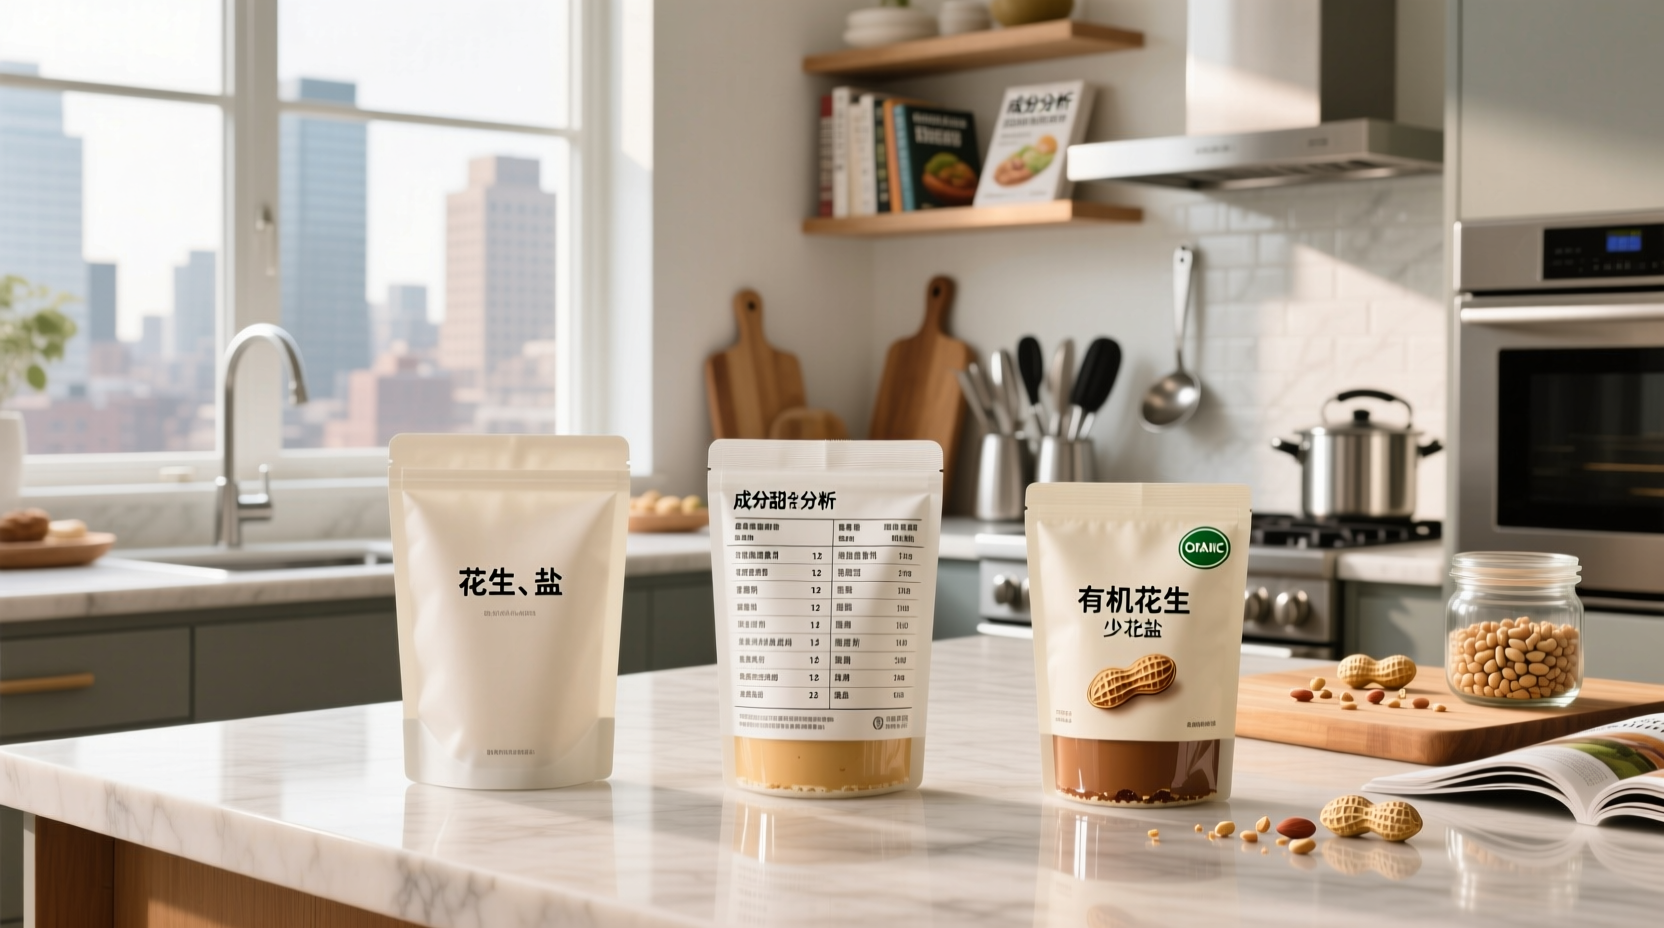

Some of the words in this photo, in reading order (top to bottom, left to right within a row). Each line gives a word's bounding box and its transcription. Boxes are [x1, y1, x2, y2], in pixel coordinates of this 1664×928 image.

[459, 567, 563, 597] 花生、盐
[1078, 585, 1190, 615] 有机花生
